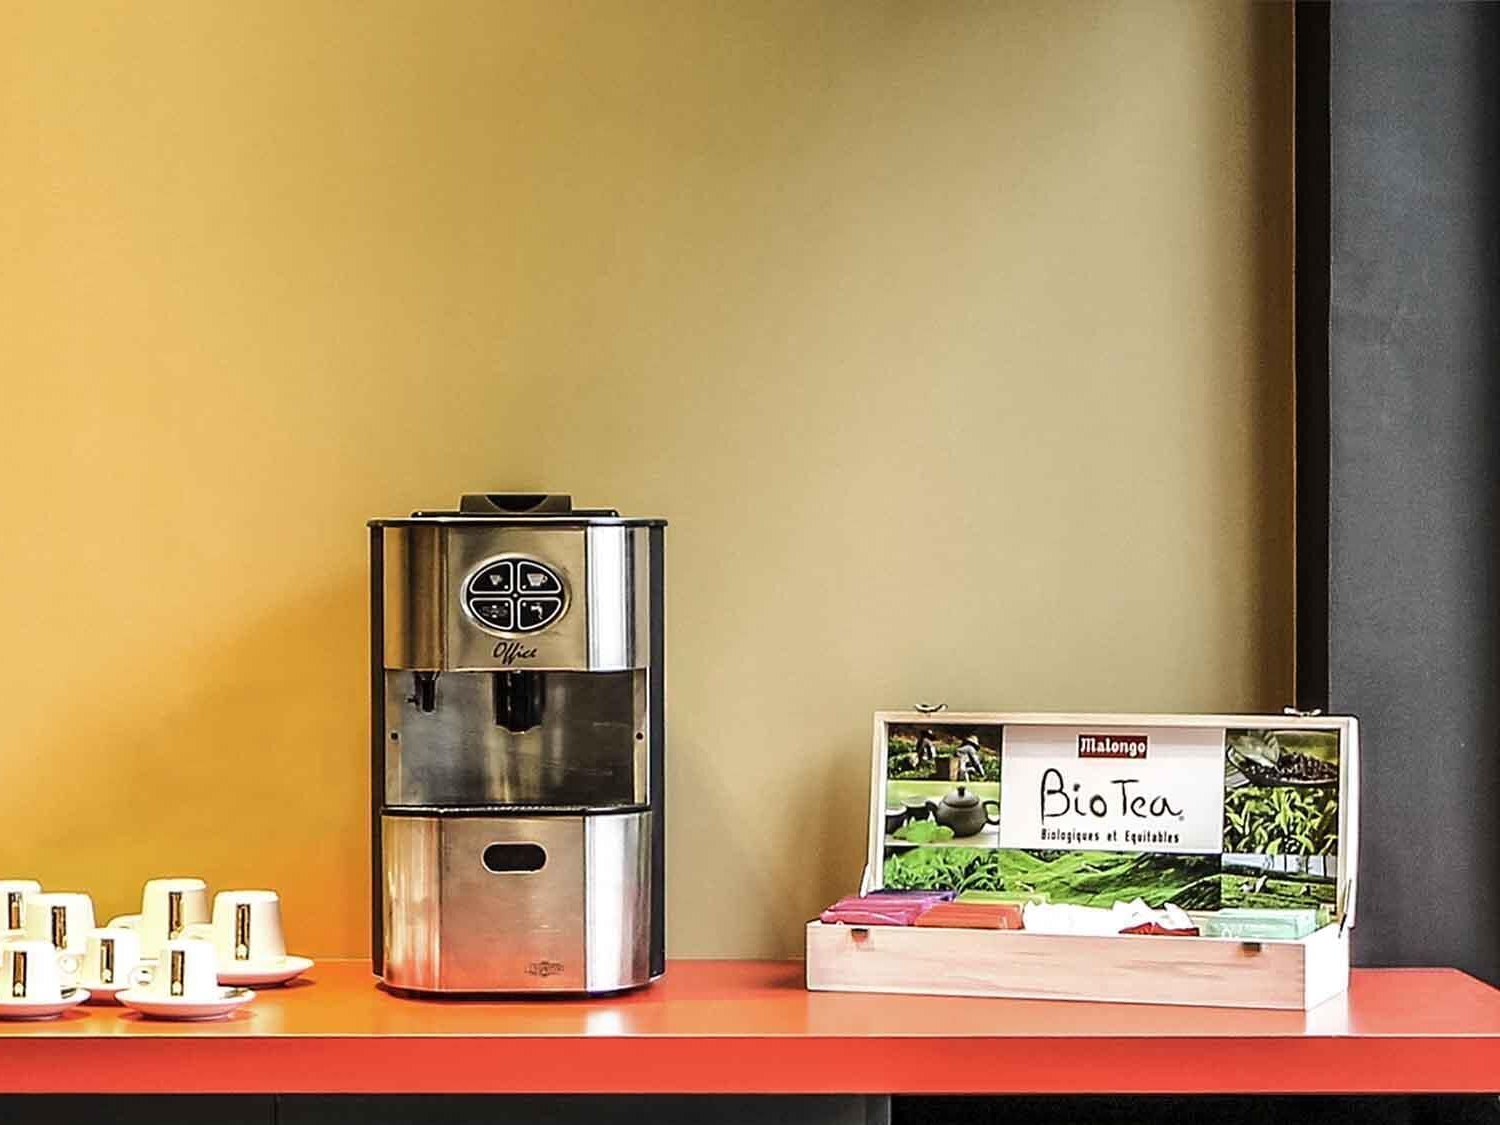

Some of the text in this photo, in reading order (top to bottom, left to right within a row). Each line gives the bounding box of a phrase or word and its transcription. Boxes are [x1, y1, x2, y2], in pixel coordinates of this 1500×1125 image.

[493, 641, 538, 666] Office
[1080, 737, 1146, 758] Malongo
[1041, 828, 1179, 845] Biologiques et Equitables
